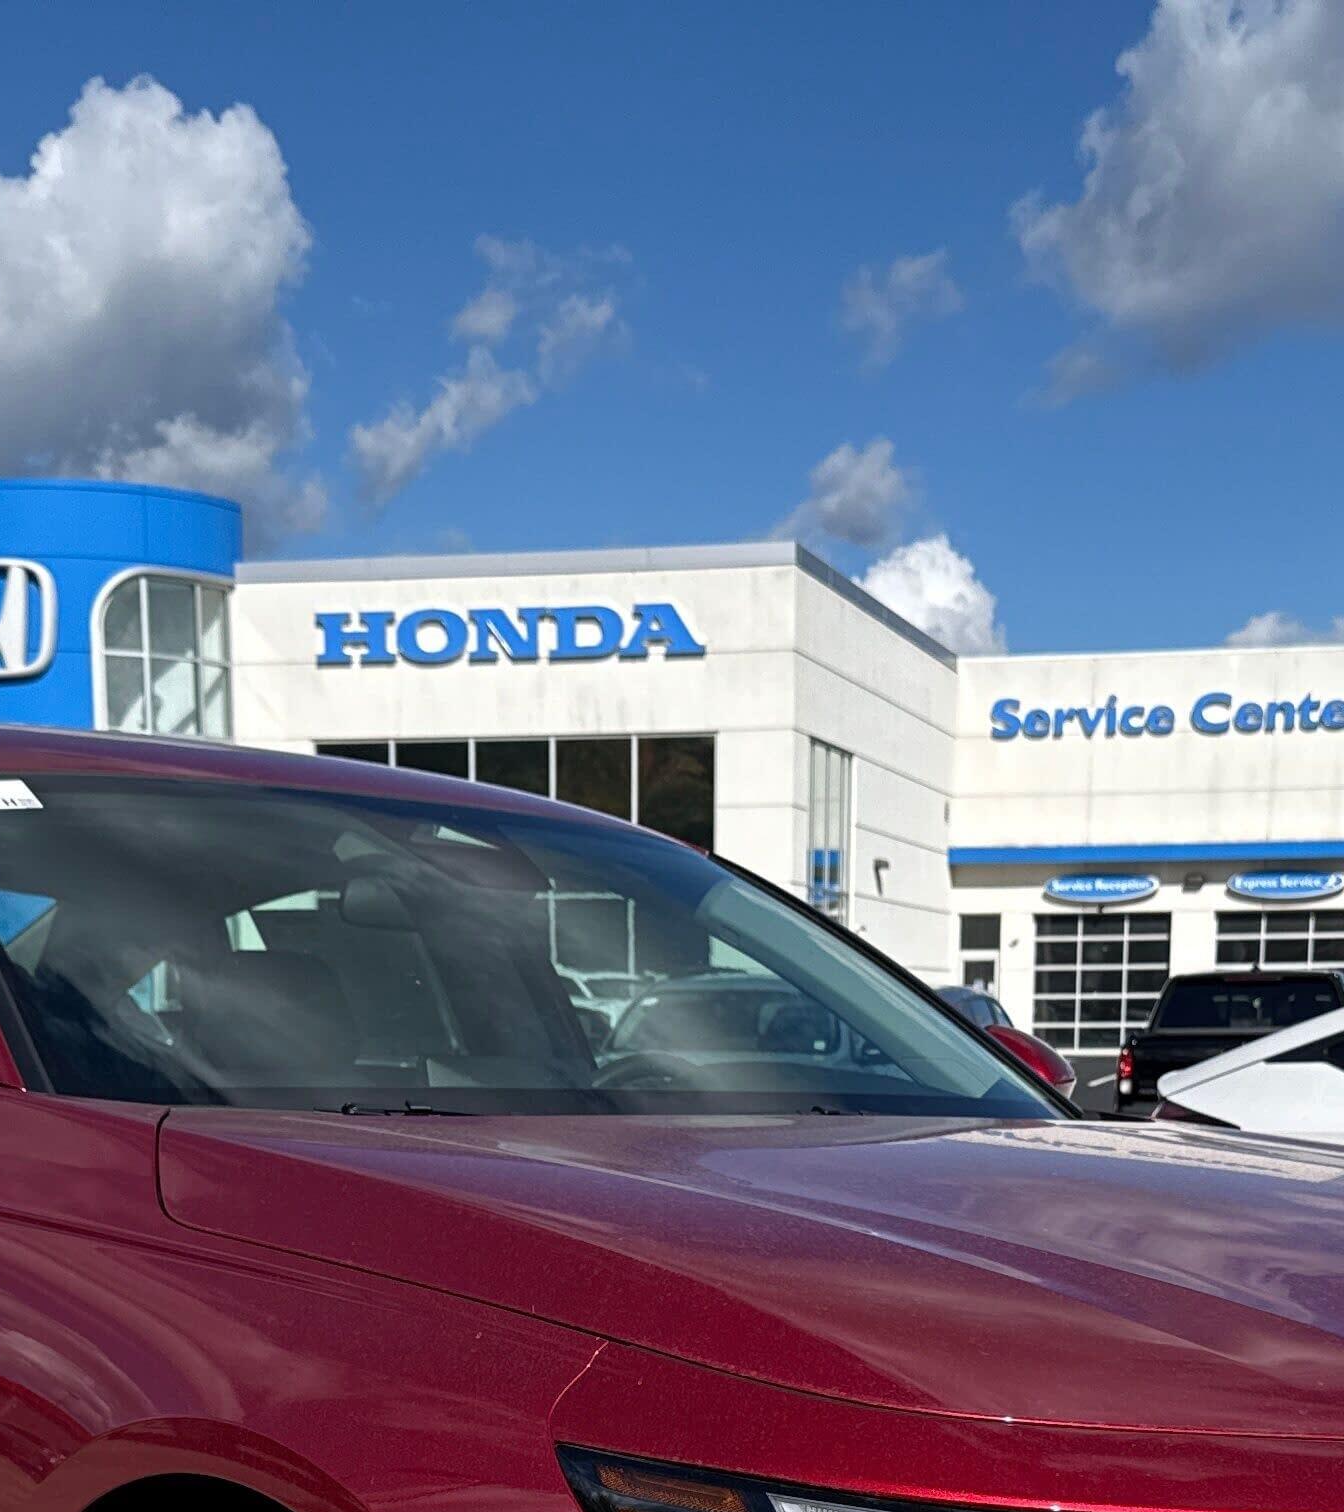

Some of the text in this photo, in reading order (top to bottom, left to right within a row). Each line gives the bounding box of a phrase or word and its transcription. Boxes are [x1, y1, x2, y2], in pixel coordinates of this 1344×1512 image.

[314, 603, 706, 668] HONDA
[990, 694, 1176, 742] Service
[1051, 880, 1092, 892] Service
[1235, 876, 1322, 891] Express Service
